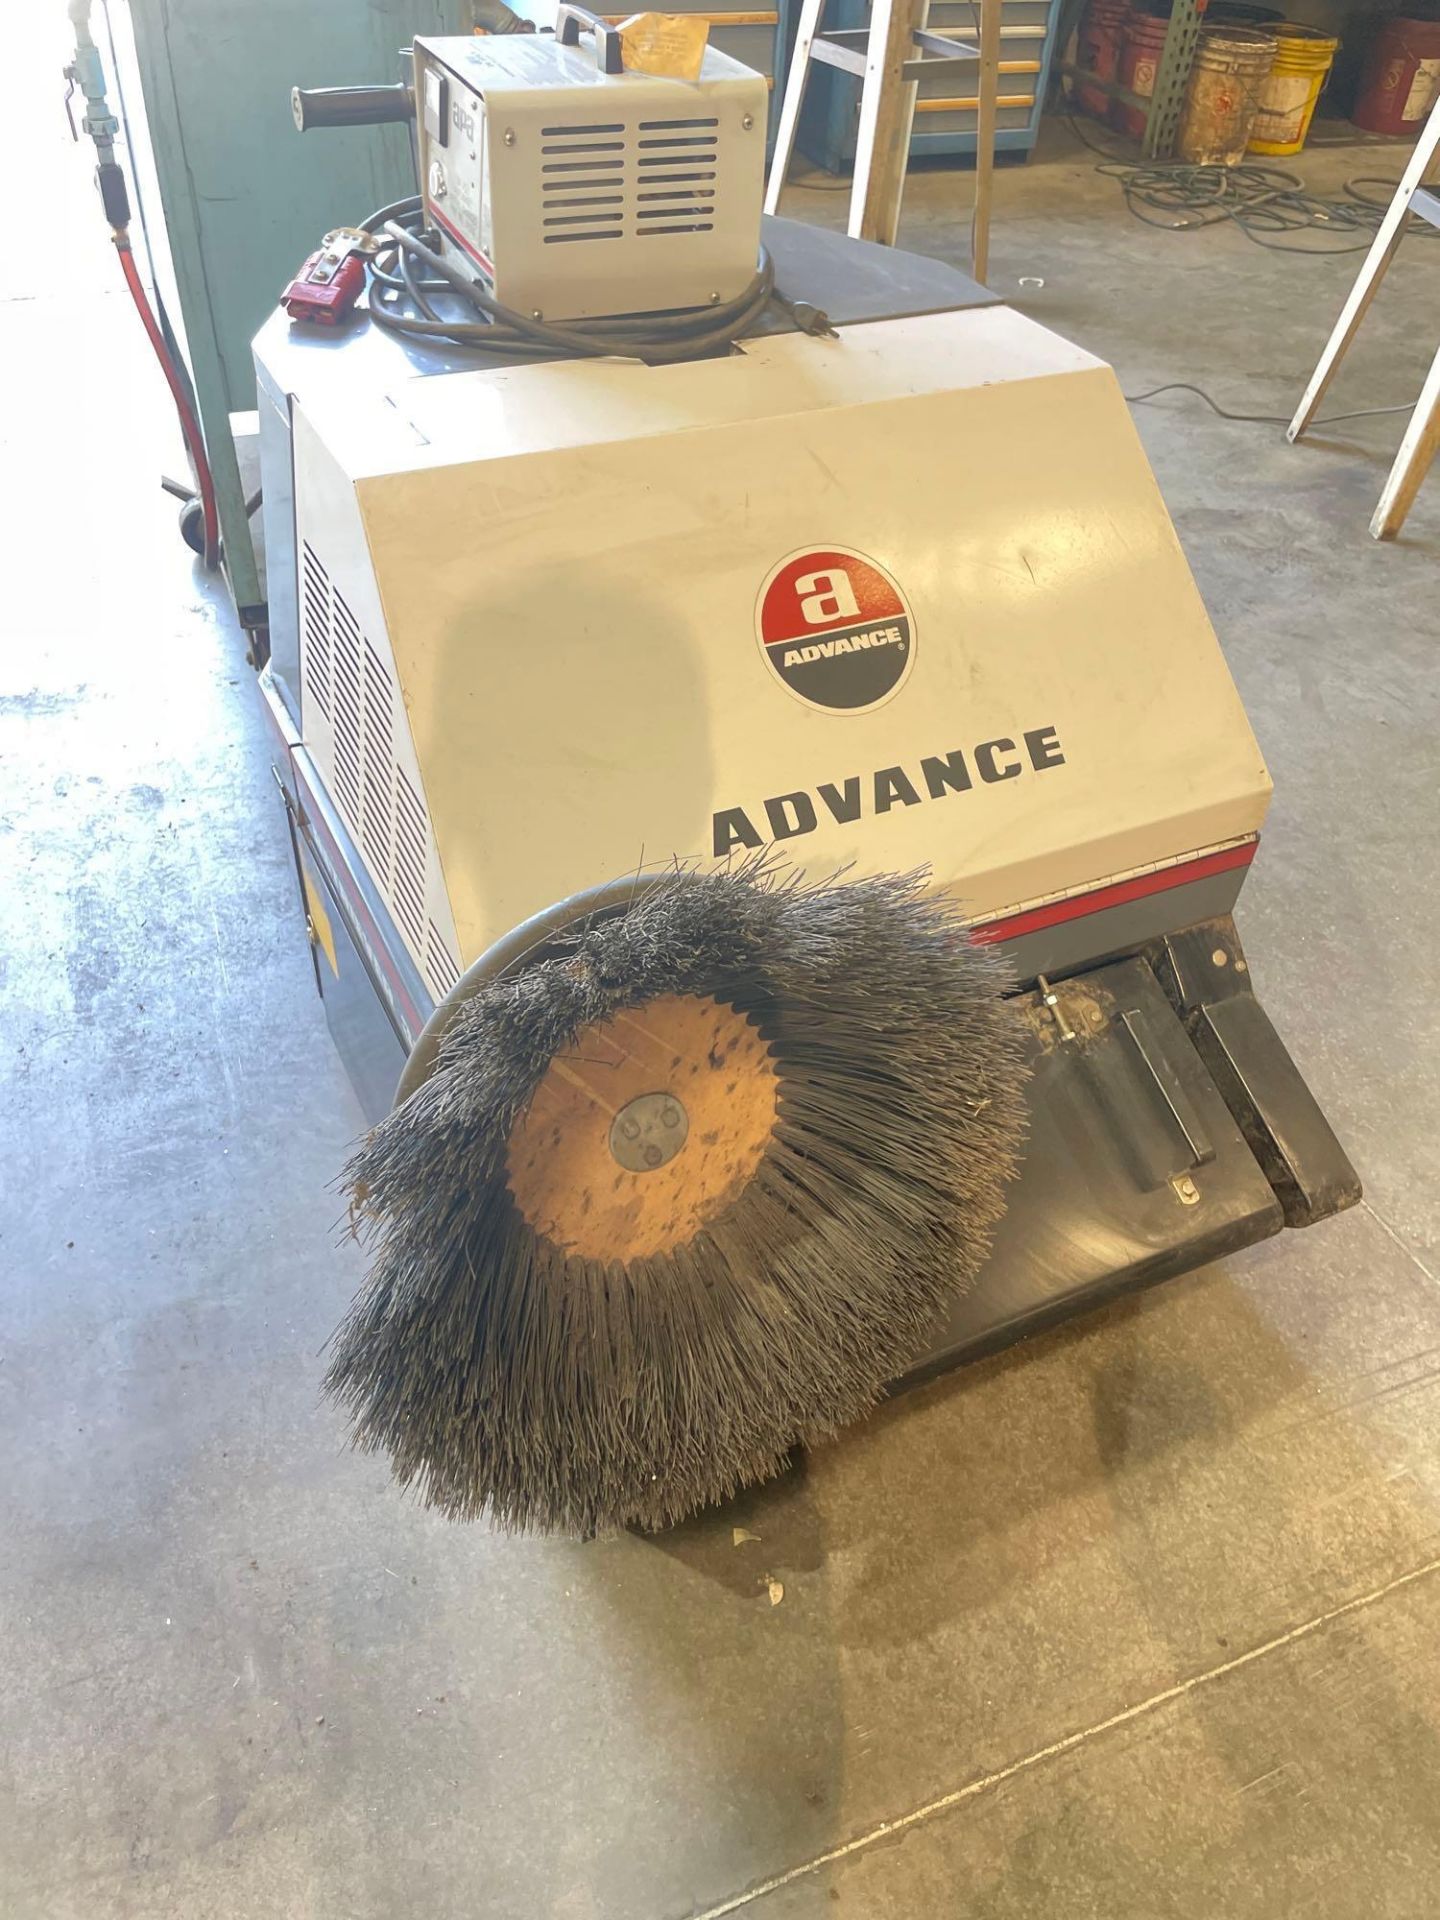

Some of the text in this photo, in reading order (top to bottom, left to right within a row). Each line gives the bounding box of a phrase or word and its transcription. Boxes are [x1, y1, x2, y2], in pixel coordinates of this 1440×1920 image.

[795, 568, 861, 625] a
[783, 627, 901, 667] ADVANCE
[713, 726, 1065, 857] ADVANCE
